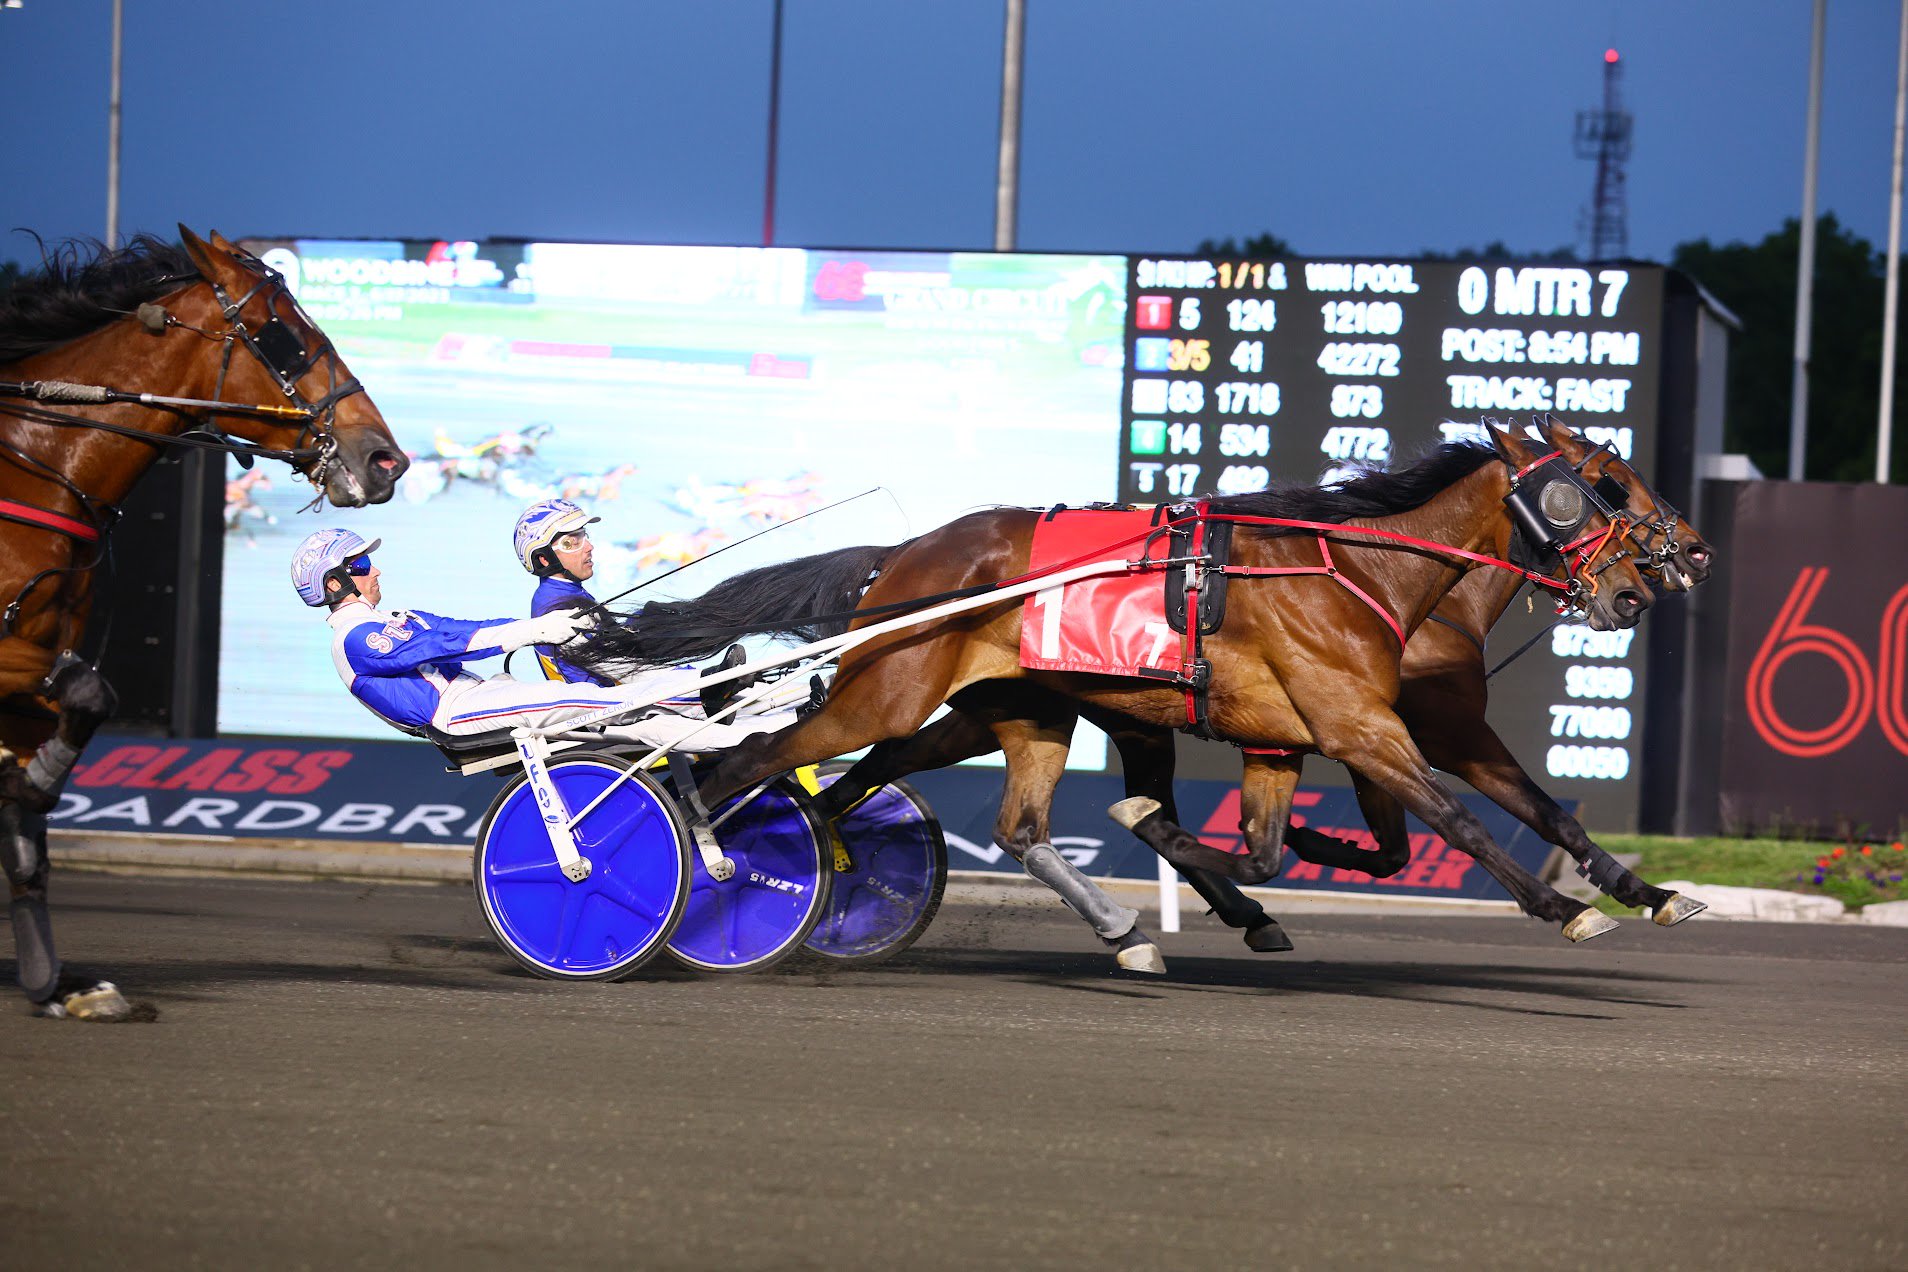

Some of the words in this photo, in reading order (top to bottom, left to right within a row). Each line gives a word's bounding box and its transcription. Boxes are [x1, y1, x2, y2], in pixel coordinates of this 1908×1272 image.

[1306, 263, 1352, 291] WIN
[1353, 264, 1419, 293] POOL
[1458, 267, 1488, 315] 0
[1599, 270, 1629, 317] 7
[1180, 298, 1200, 330] 5
[1227, 299, 1276, 331] 124
[1167, 339, 1210, 371] 3/5
[1230, 341, 1263, 372] 41
[1317, 343, 1401, 376] 42272
[1442, 328, 1526, 362] POST:
[1591, 332, 1640, 365] PM
[1168, 380, 1204, 413] 83
[1447, 375, 1552, 411] TRACK:
[1555, 378, 1631, 412] FAST
[1167, 422, 1201, 454] 14
[1219, 424, 1270, 457] 534
[1321, 426, 1389, 460] 4772
[1165, 464, 1200, 495] 17
[1034, 582, 1065, 660] 1
[1145, 622, 1169, 666] 7
[566, 711, 598, 728] SCOTT
